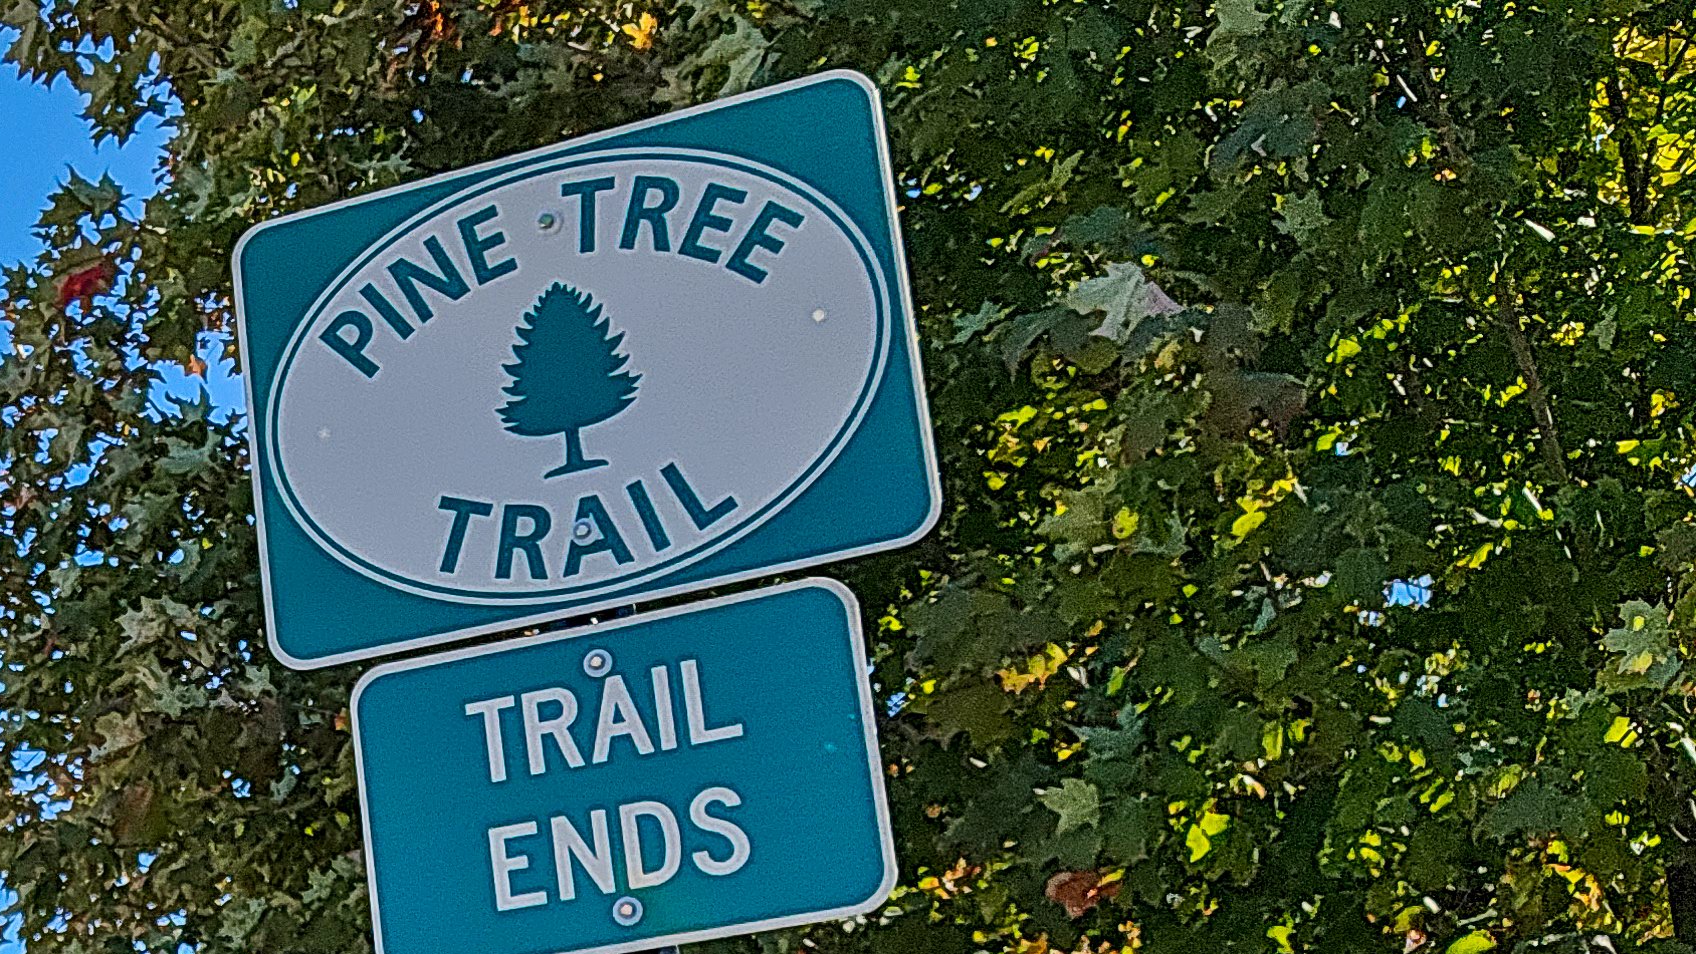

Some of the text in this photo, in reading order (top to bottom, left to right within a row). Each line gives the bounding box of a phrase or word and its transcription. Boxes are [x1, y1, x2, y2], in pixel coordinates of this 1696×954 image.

[318, 175, 805, 379] PINE TREE
[438, 461, 739, 580] TRAIL
[464, 658, 744, 783] TRAIL
[487, 786, 751, 912] ENDS
